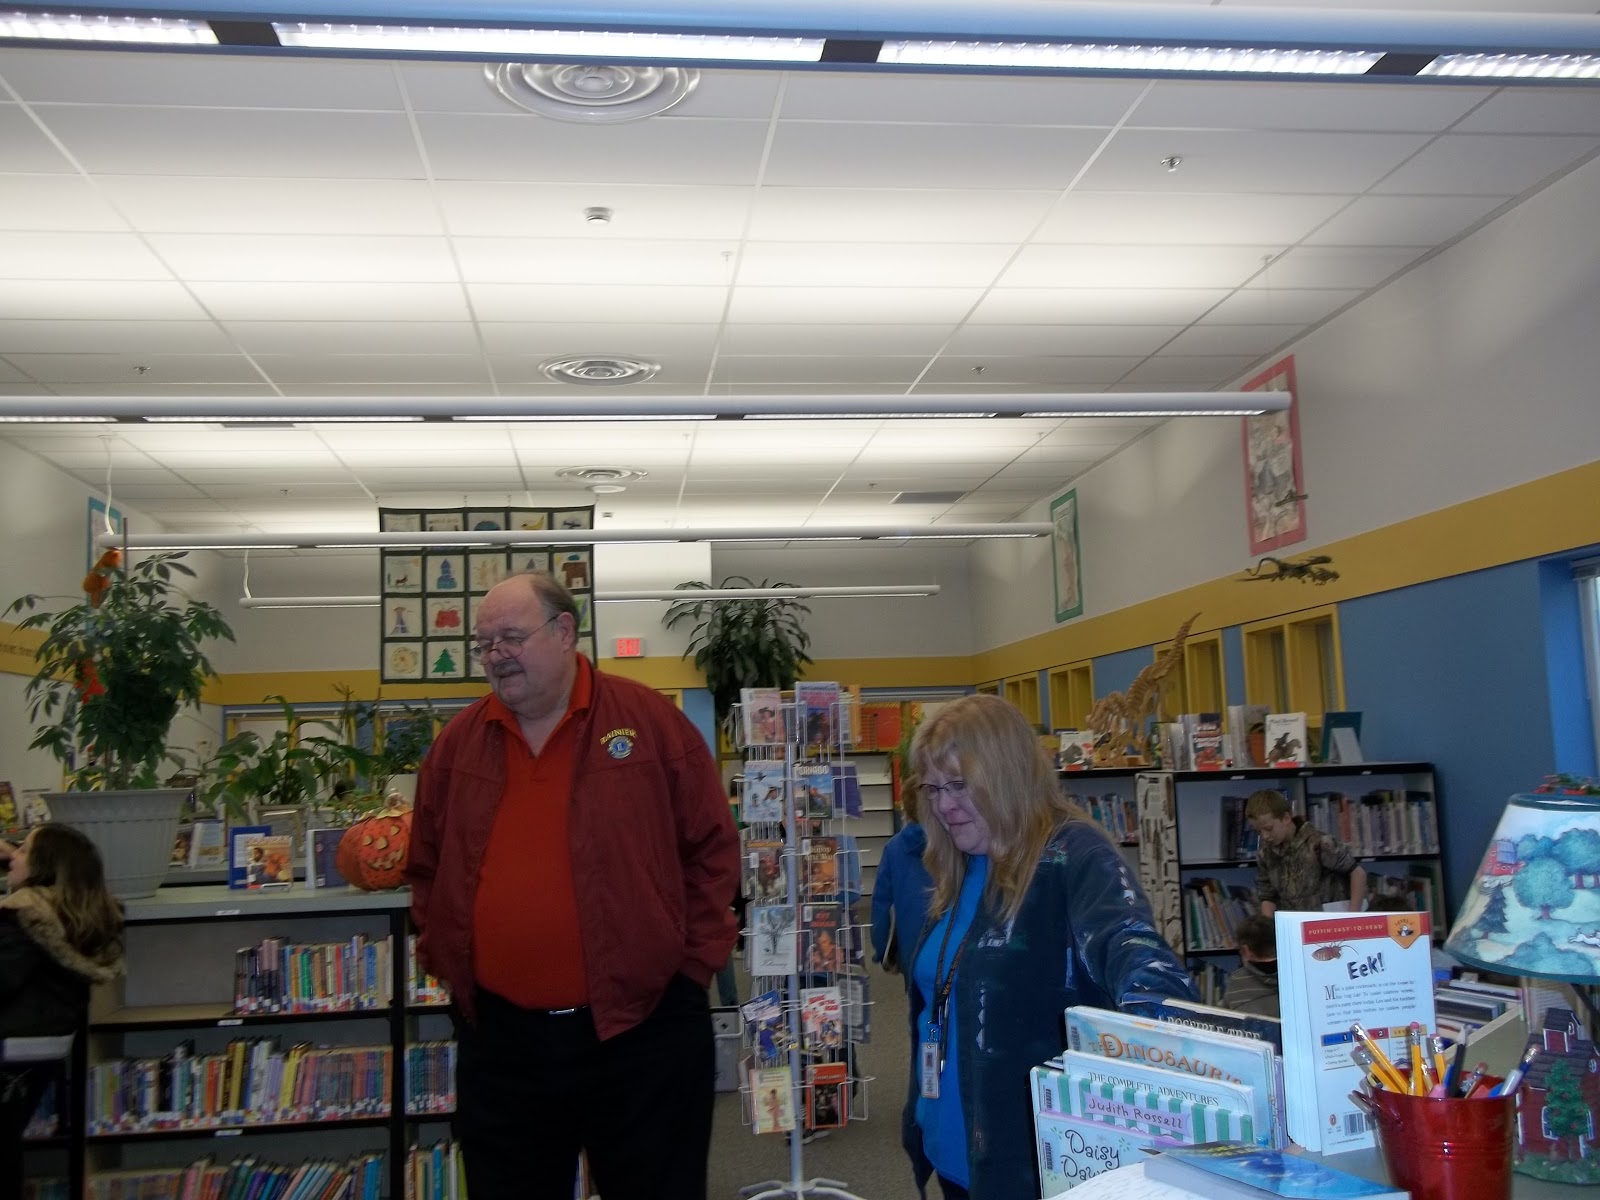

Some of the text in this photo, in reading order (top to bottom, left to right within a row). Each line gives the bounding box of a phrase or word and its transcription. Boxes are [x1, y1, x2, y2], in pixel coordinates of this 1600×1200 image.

[1333, 924, 1384, 933] EASY-TO-READ
[1346, 952, 1386, 981] Eek!
[1087, 1072, 1220, 1106] THE COMPLETE ADVENTURES
[1089, 1099, 1183, 1129] Judith Rossell
[1065, 1129, 1120, 1170] Daisy
